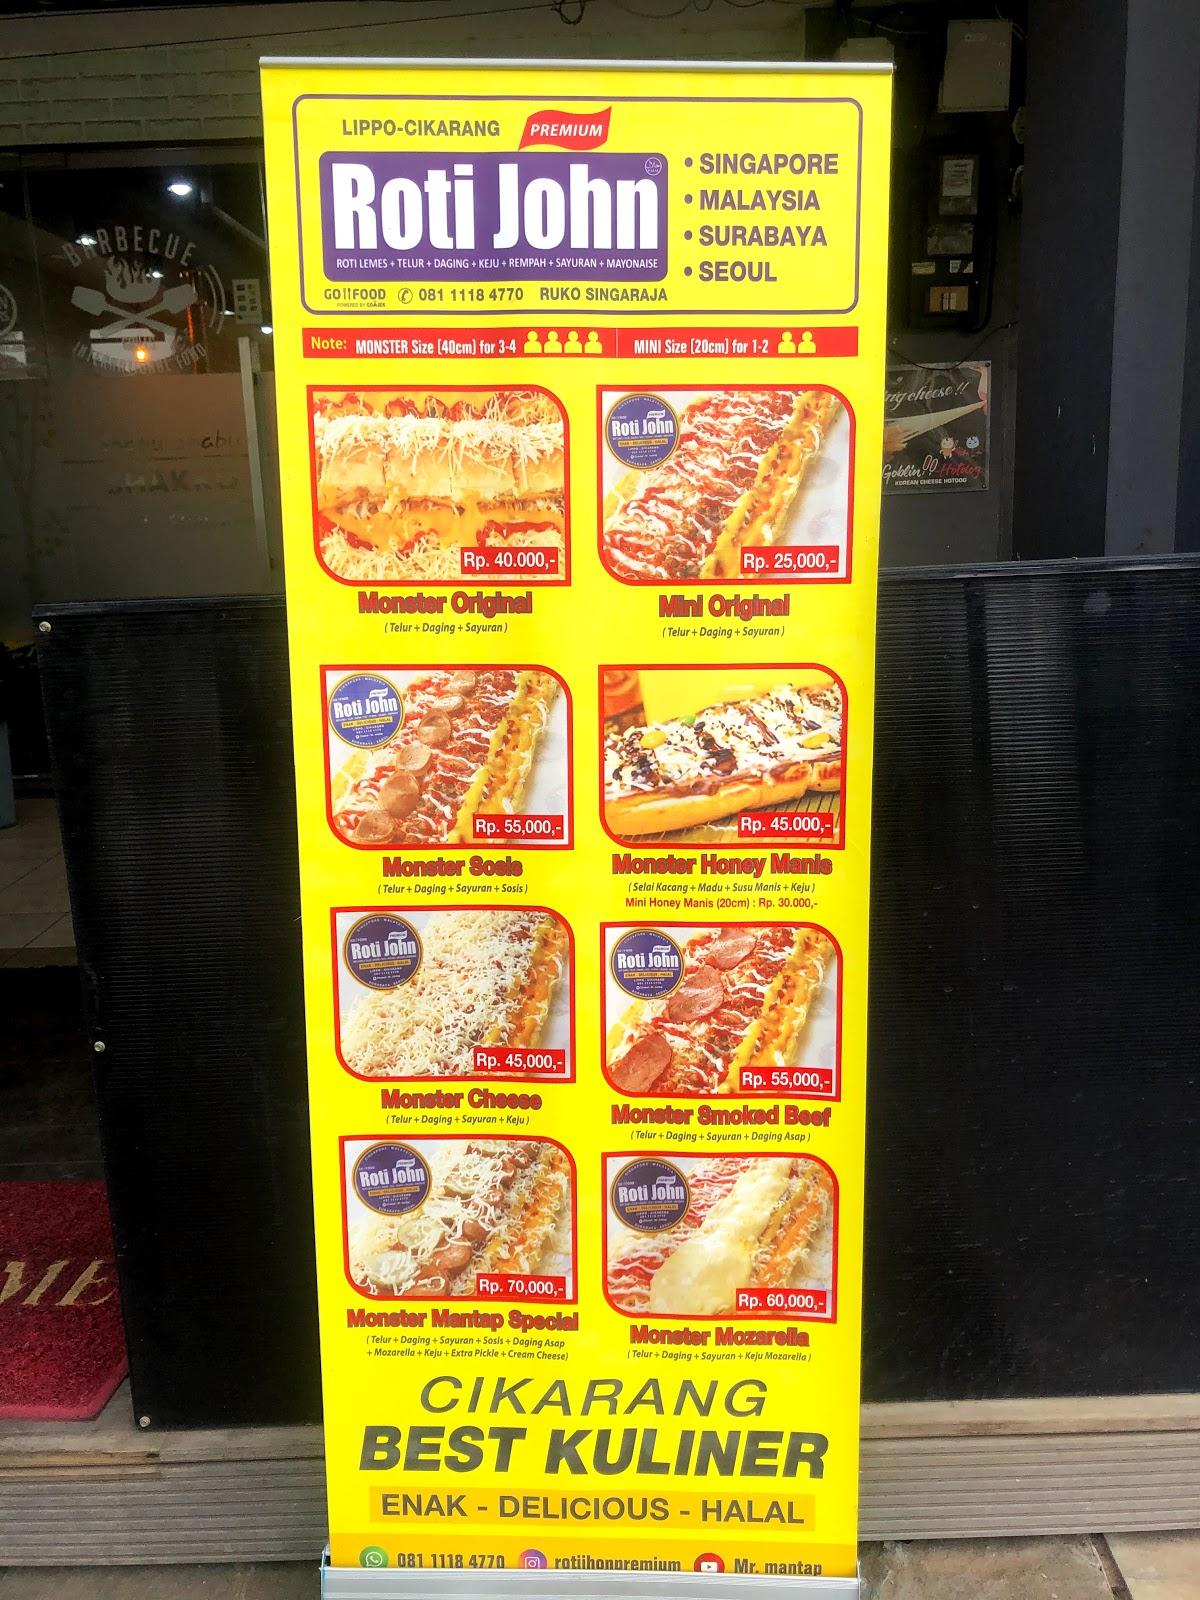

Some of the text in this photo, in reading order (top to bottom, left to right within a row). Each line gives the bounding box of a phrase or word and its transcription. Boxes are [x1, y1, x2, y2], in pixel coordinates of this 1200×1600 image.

[342, 119, 500, 137] LIPPO-CIKARANG
[530, 124, 603, 137] PREMIUM
[699, 153, 838, 175] SINGAPORE
[331, 163, 658, 250] Roti John
[700, 190, 820, 211] MALAYSIA
[62, 226, 196, 267] BARBECUE
[699, 225, 828, 247] SURABAYA
[336, 258, 658, 269] ROTI LEMES TELUR DAGING KEJU REMPAH SAYURAN MAYONAISE
[699, 261, 777, 282] SEOUL
[419, 287, 668, 301] 081 1118 4770 RUKO SINGARAJA
[310, 337, 347, 350] Note:
[355, 339, 408, 354] MONSTER
[411, 339, 434, 354] Size
[479, 339, 496, 354] for
[499, 339, 516, 354] 3-4
[634, 340, 661, 354] MINI
[664, 340, 687, 354] Size
[732, 339, 748, 354] for
[752, 339, 769, 354] 1-2
[611, 418, 674, 437] Roti John
[463, 551, 555, 571] Rp. 40.000,-
[743, 553, 837, 572] Rp. 25,000,-
[358, 591, 533, 618] Monster Original
[658, 593, 791, 622] Mini Original
[333, 697, 398, 719] Roti John
[475, 819, 561, 836] Rp. 55,000,-
[741, 816, 831, 834] Rp. 45.000,-
[382, 855, 523, 878] Monster Sosis
[612, 853, 833, 878] Monster Honey Manis
[626, 897, 818, 910] Mini Honey Manis (20cm) Rp. 30.000,-
[350, 939, 417, 960] Roti John
[617, 951, 679, 969] Roti John
[476, 1053, 563, 1072] Rp. 45,000,-
[742, 1071, 830, 1090] Rp. 55,000,-
[381, 1087, 543, 1111] Monster Cheese
[611, 1104, 831, 1128] Monster Smoked Beef
[359, 1166, 425, 1188] Roti John
[618, 1183, 685, 1203] Roti John
[479, 1278, 564, 1297] Rp. 70,000,-
[738, 1294, 824, 1312] Rp. 60,000,-
[347, 1308, 579, 1333] Monster Mantap Special
[629, 1324, 810, 1347] Monster Mozarella
[420, 1375, 769, 1417] CIKARANG
[359, 1424, 829, 1480] BEST KULINER
[382, 1493, 805, 1525] ENAK DELICIOUS HALAL
[397, 1552, 505, 1569] 081 1118 4770
[734, 1558, 822, 1576] Mr. mantap
